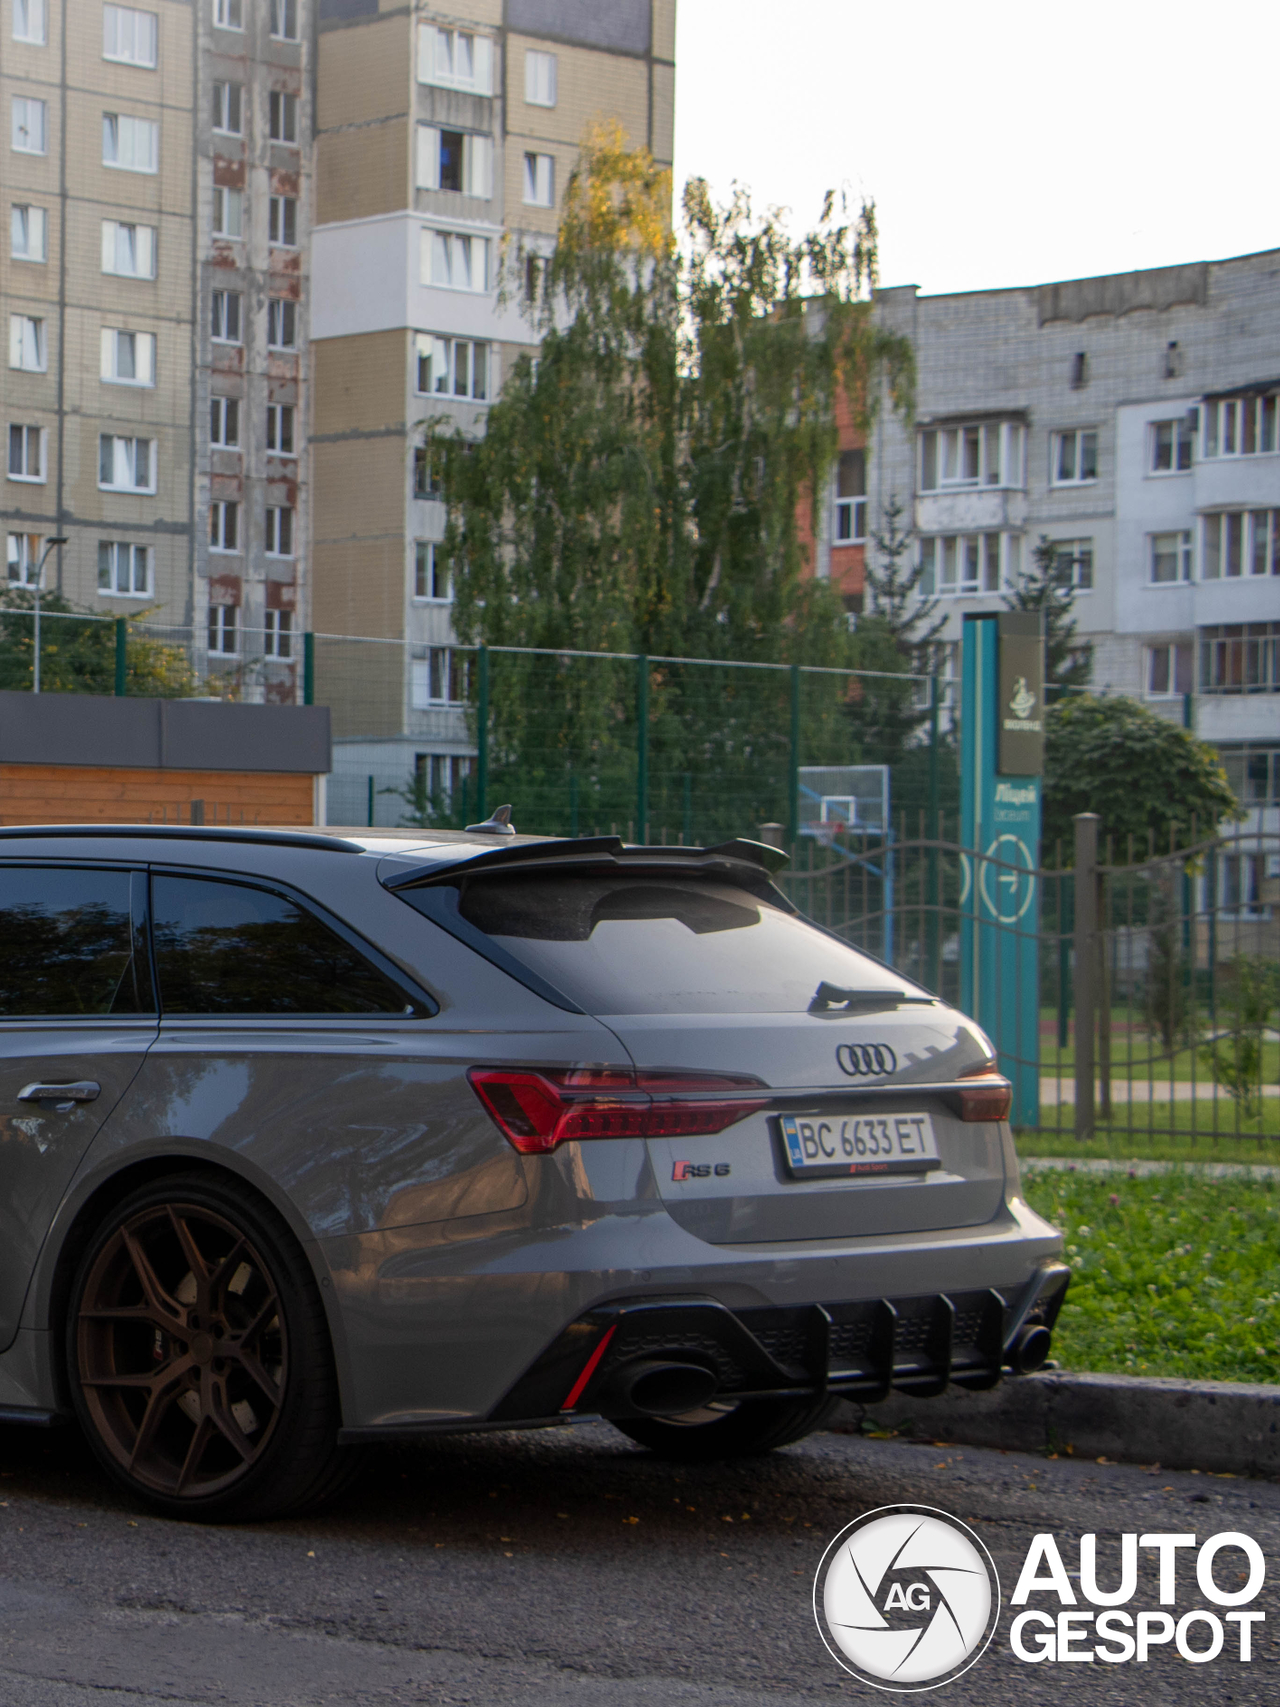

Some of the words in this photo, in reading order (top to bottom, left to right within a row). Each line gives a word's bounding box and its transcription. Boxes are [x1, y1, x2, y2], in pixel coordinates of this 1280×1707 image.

[995, 783, 1036, 806] Ліцей
[799, 1122, 835, 1158] BC
[841, 1120, 893, 1156] 6633
[894, 1117, 926, 1153] ET
[714, 1162, 731, 1177] 6
[870, 1162, 888, 1172] Sport
